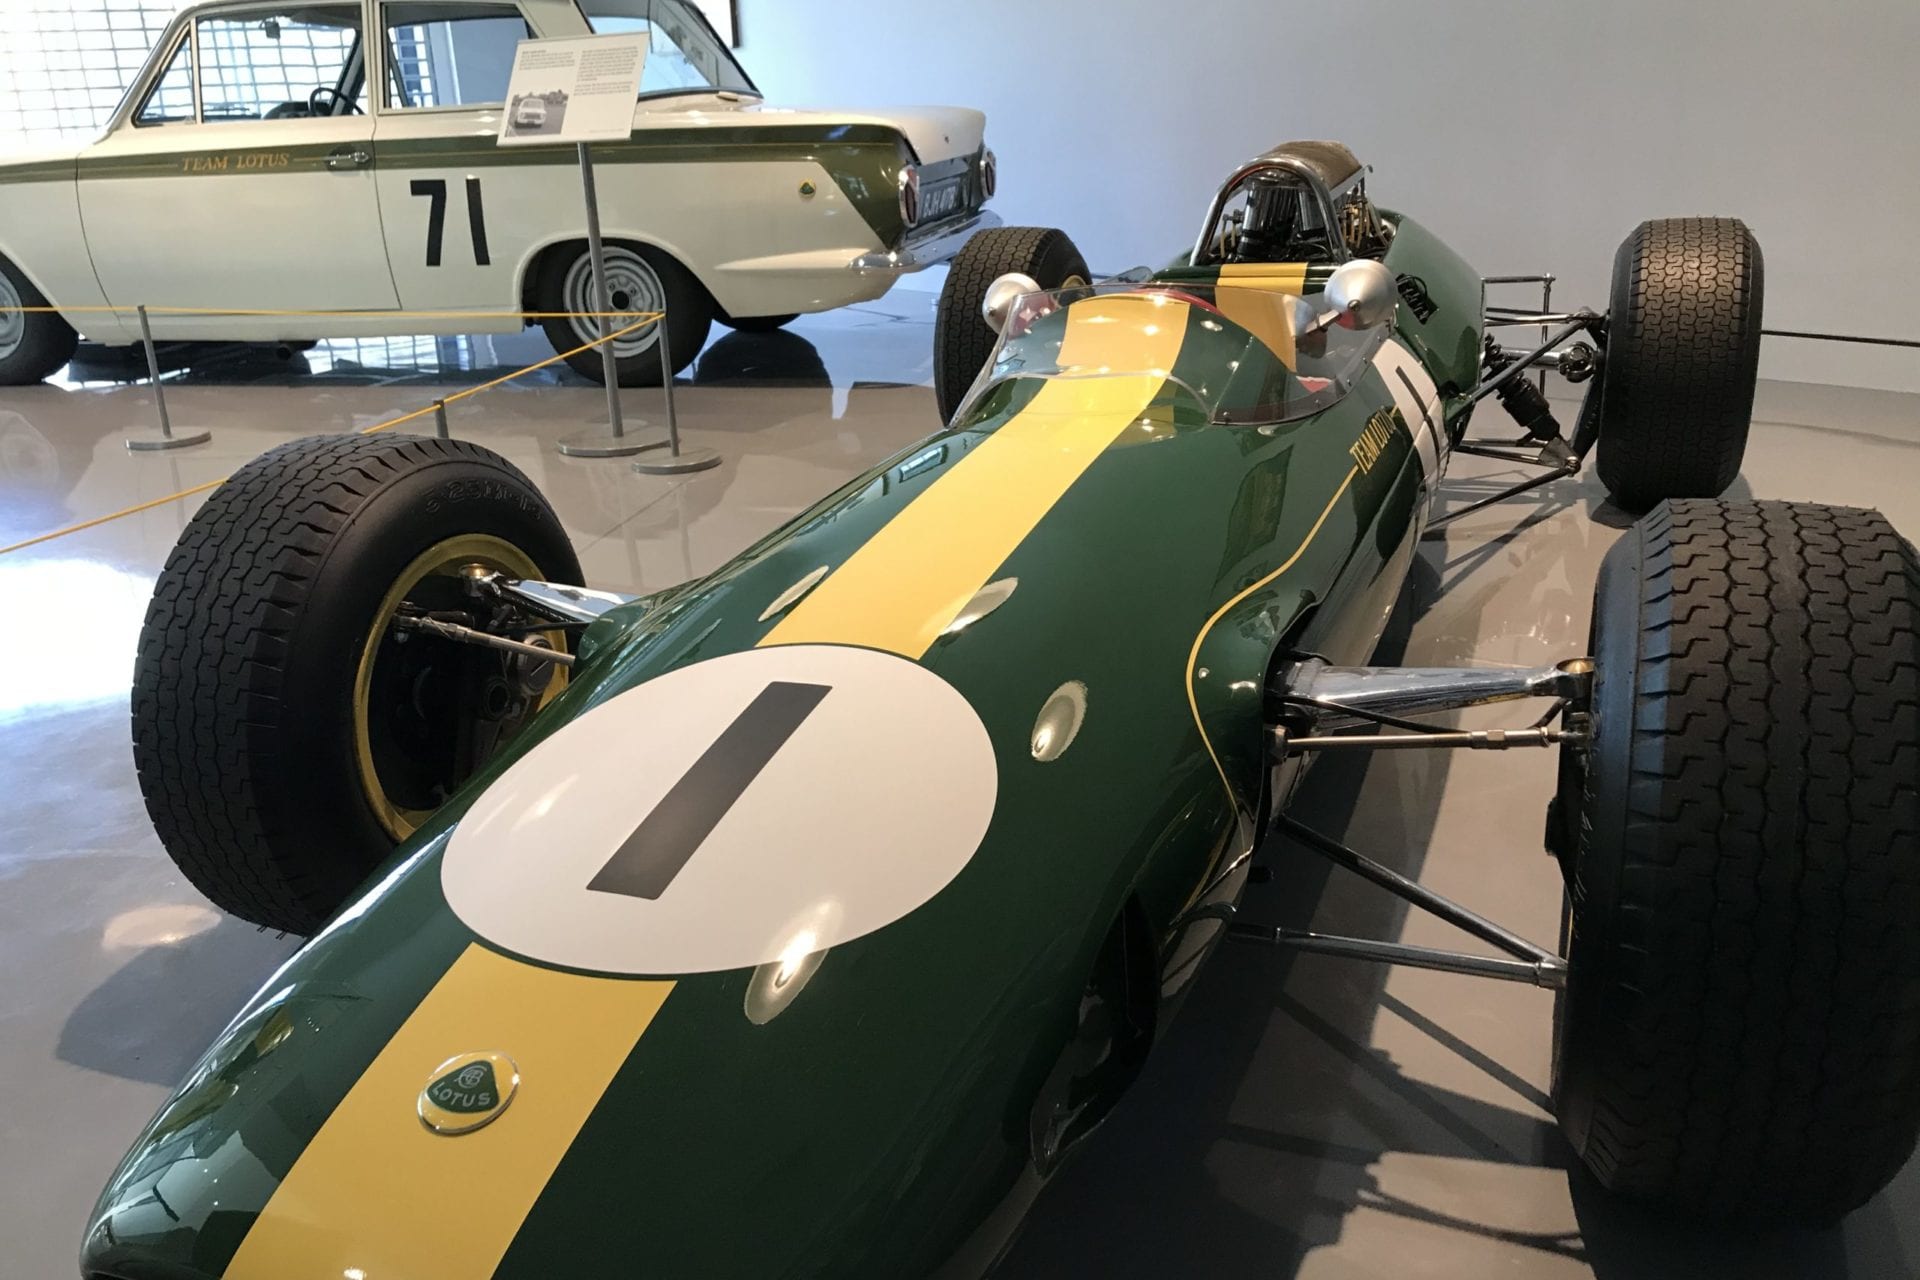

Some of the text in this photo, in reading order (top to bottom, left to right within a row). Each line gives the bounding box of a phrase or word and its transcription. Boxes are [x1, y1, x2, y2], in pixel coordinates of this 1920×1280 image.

[182, 153, 290, 171] TEAM LOTUS
[410, 178, 491, 267] 71
[1350, 429, 1380, 475] TEAM
[586, 681, 833, 900] 1
[432, 1081, 491, 1107] LOTUS
